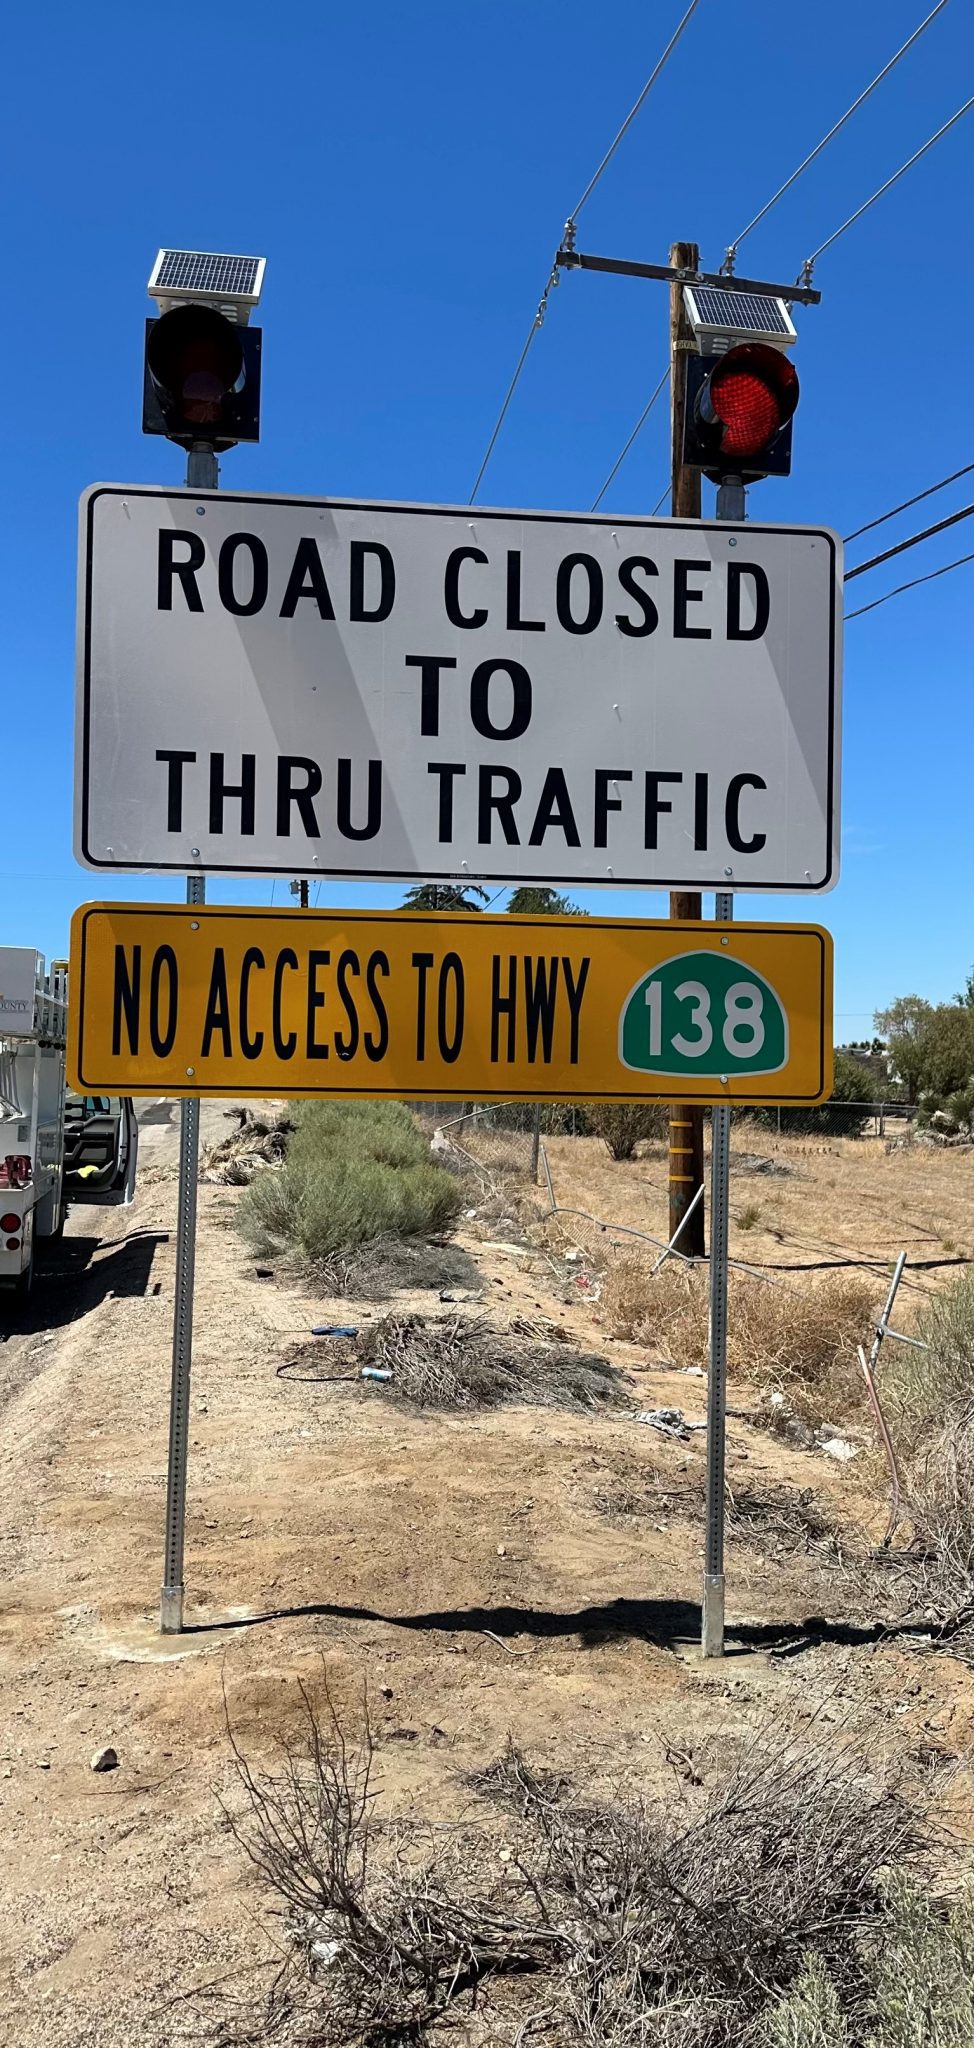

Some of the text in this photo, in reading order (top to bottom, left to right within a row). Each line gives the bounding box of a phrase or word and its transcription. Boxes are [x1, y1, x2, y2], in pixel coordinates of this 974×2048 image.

[158, 529, 770, 641] ROAD CLOSED
[406, 655, 532, 740] TO
[156, 750, 767, 853] THRU TRAFFIC
[112, 944, 590, 1064] NO ACCESS TO HWY
[645, 981, 765, 1058] 138
